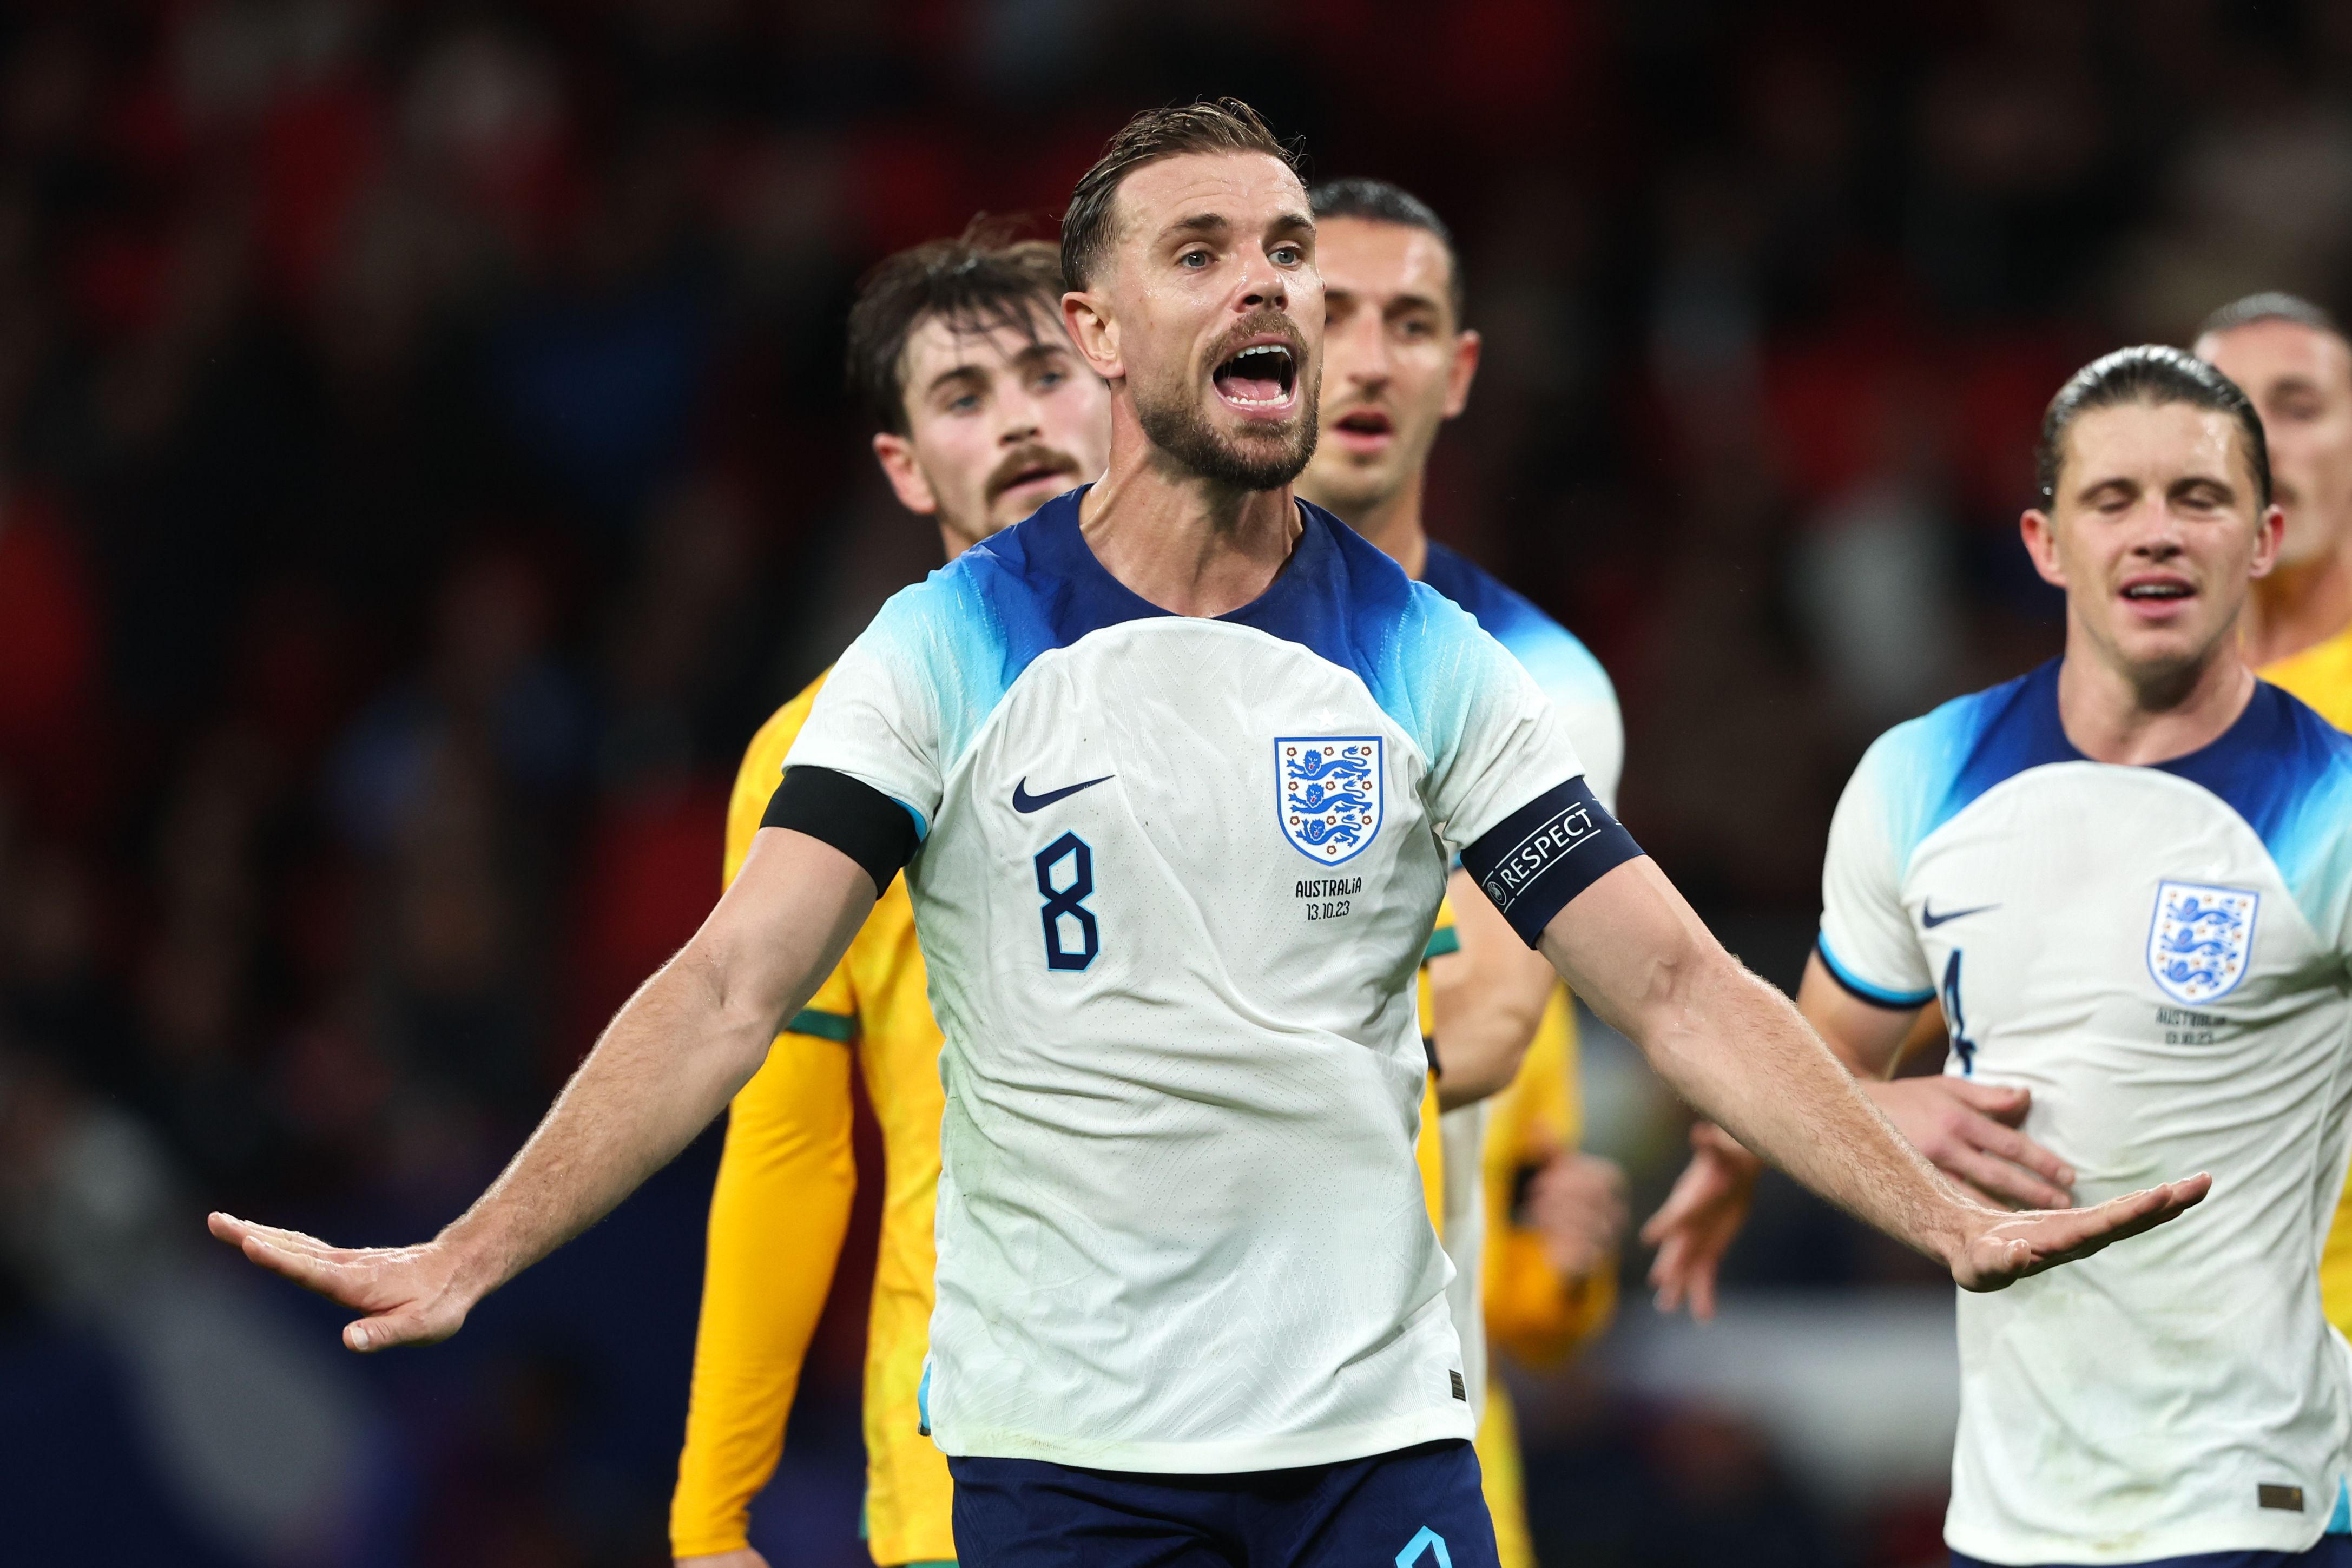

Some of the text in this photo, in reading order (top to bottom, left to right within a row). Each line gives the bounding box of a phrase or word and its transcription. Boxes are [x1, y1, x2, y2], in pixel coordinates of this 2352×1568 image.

[1500, 808, 1592, 889] RESPECT
[1033, 829, 1099, 972] 8
[1306, 900, 1350, 920] 13.10.23
